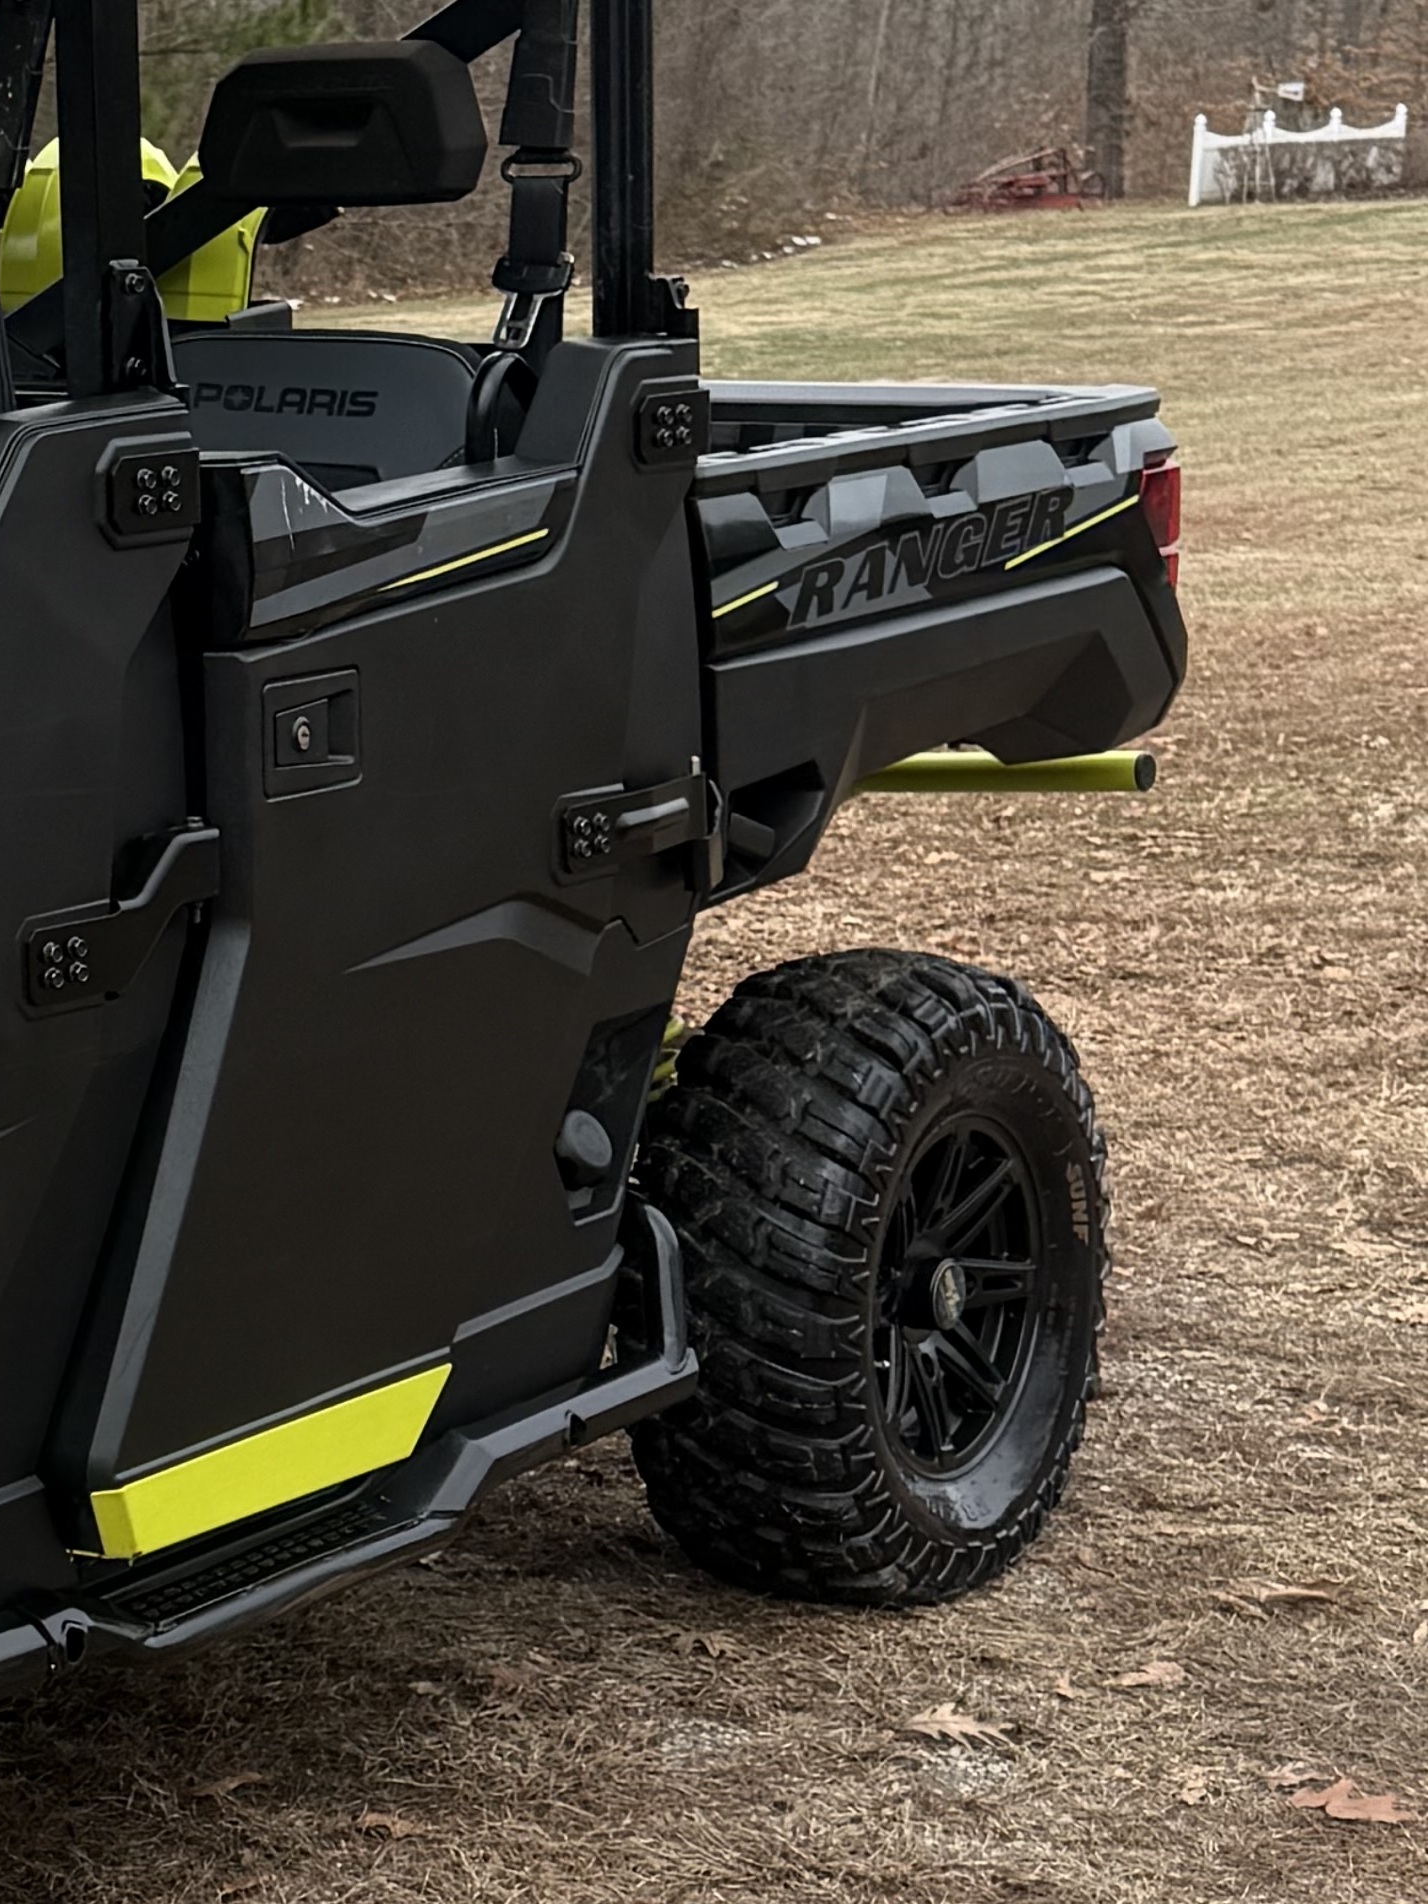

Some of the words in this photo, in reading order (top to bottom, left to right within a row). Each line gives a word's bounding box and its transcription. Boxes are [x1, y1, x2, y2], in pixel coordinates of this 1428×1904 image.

[194, 383, 377, 416] POLARIS
[788, 486, 1074, 629] RANGER
[1066, 1163, 1089, 1245] SUNF
